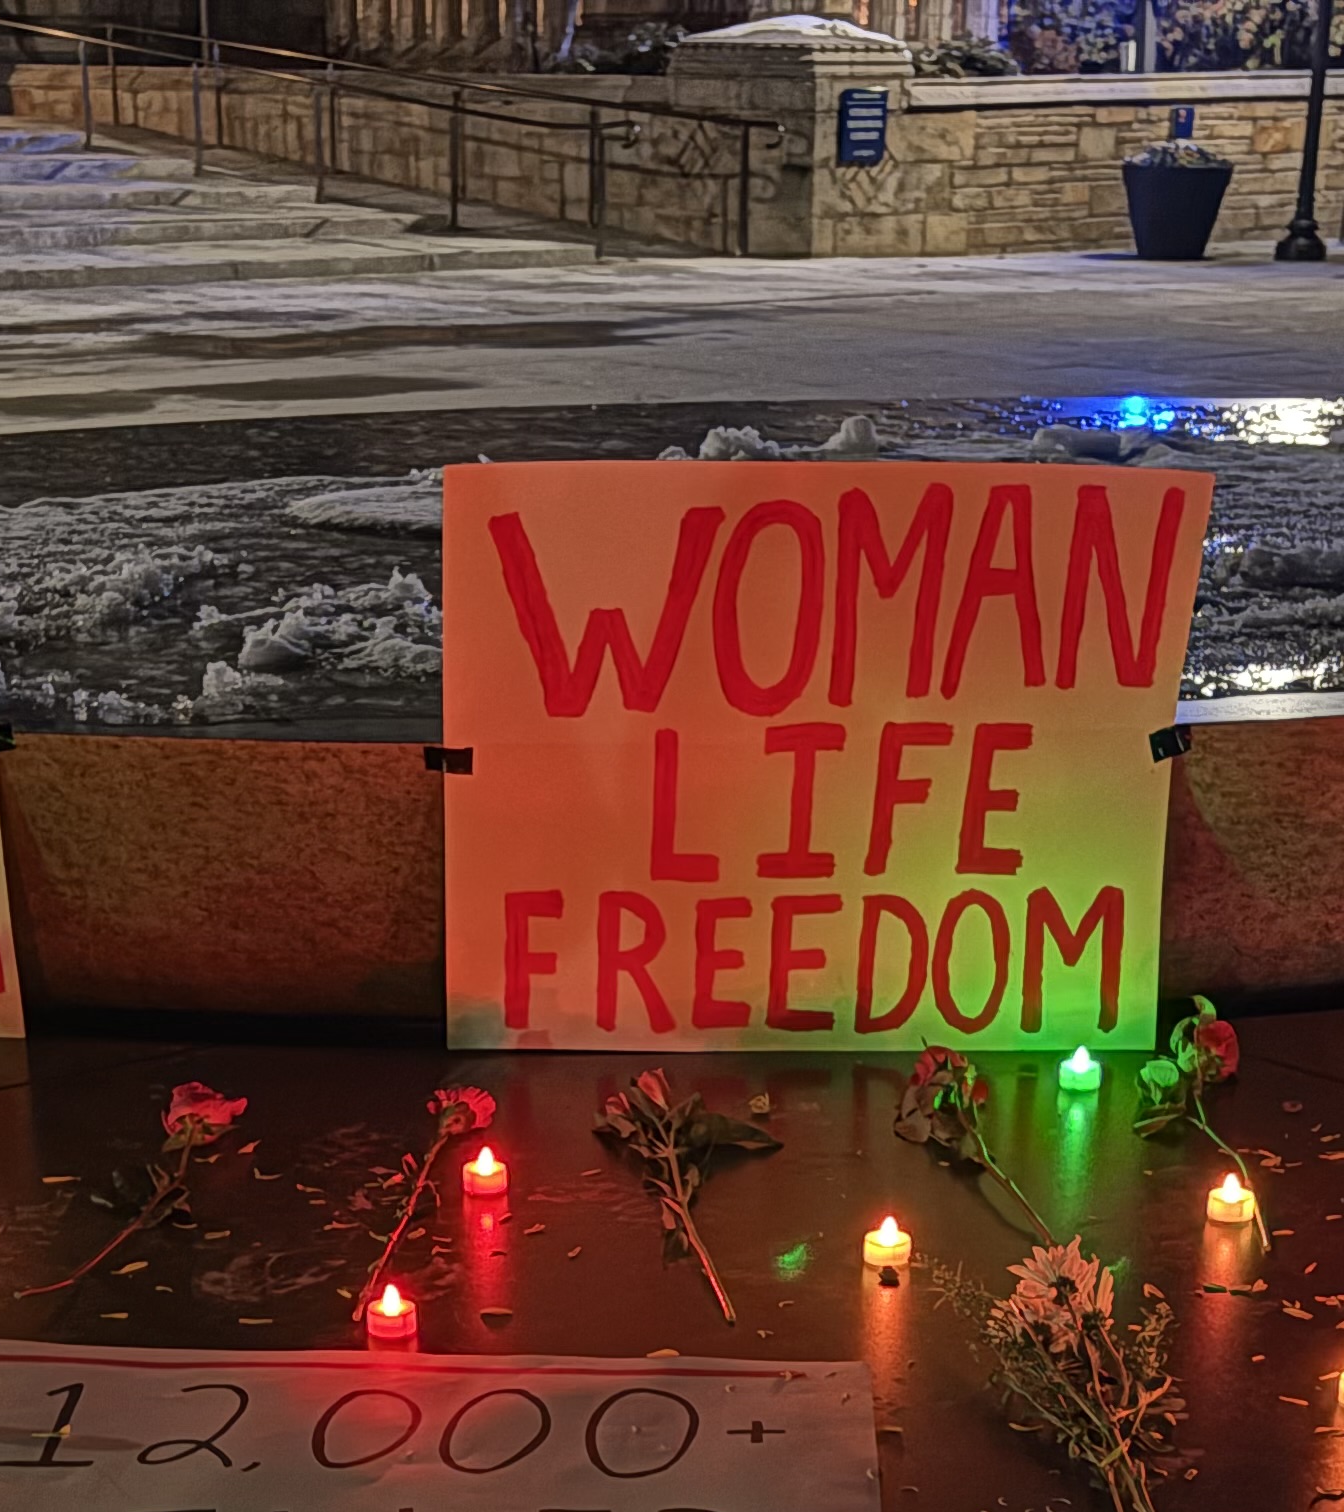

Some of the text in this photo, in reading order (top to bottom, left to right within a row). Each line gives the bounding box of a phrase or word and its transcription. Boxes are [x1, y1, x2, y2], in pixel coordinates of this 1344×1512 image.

[488, 483, 1186, 718] WOMAN
[650, 722, 1034, 883] LIFE
[503, 886, 1126, 1035] FREEDOM
